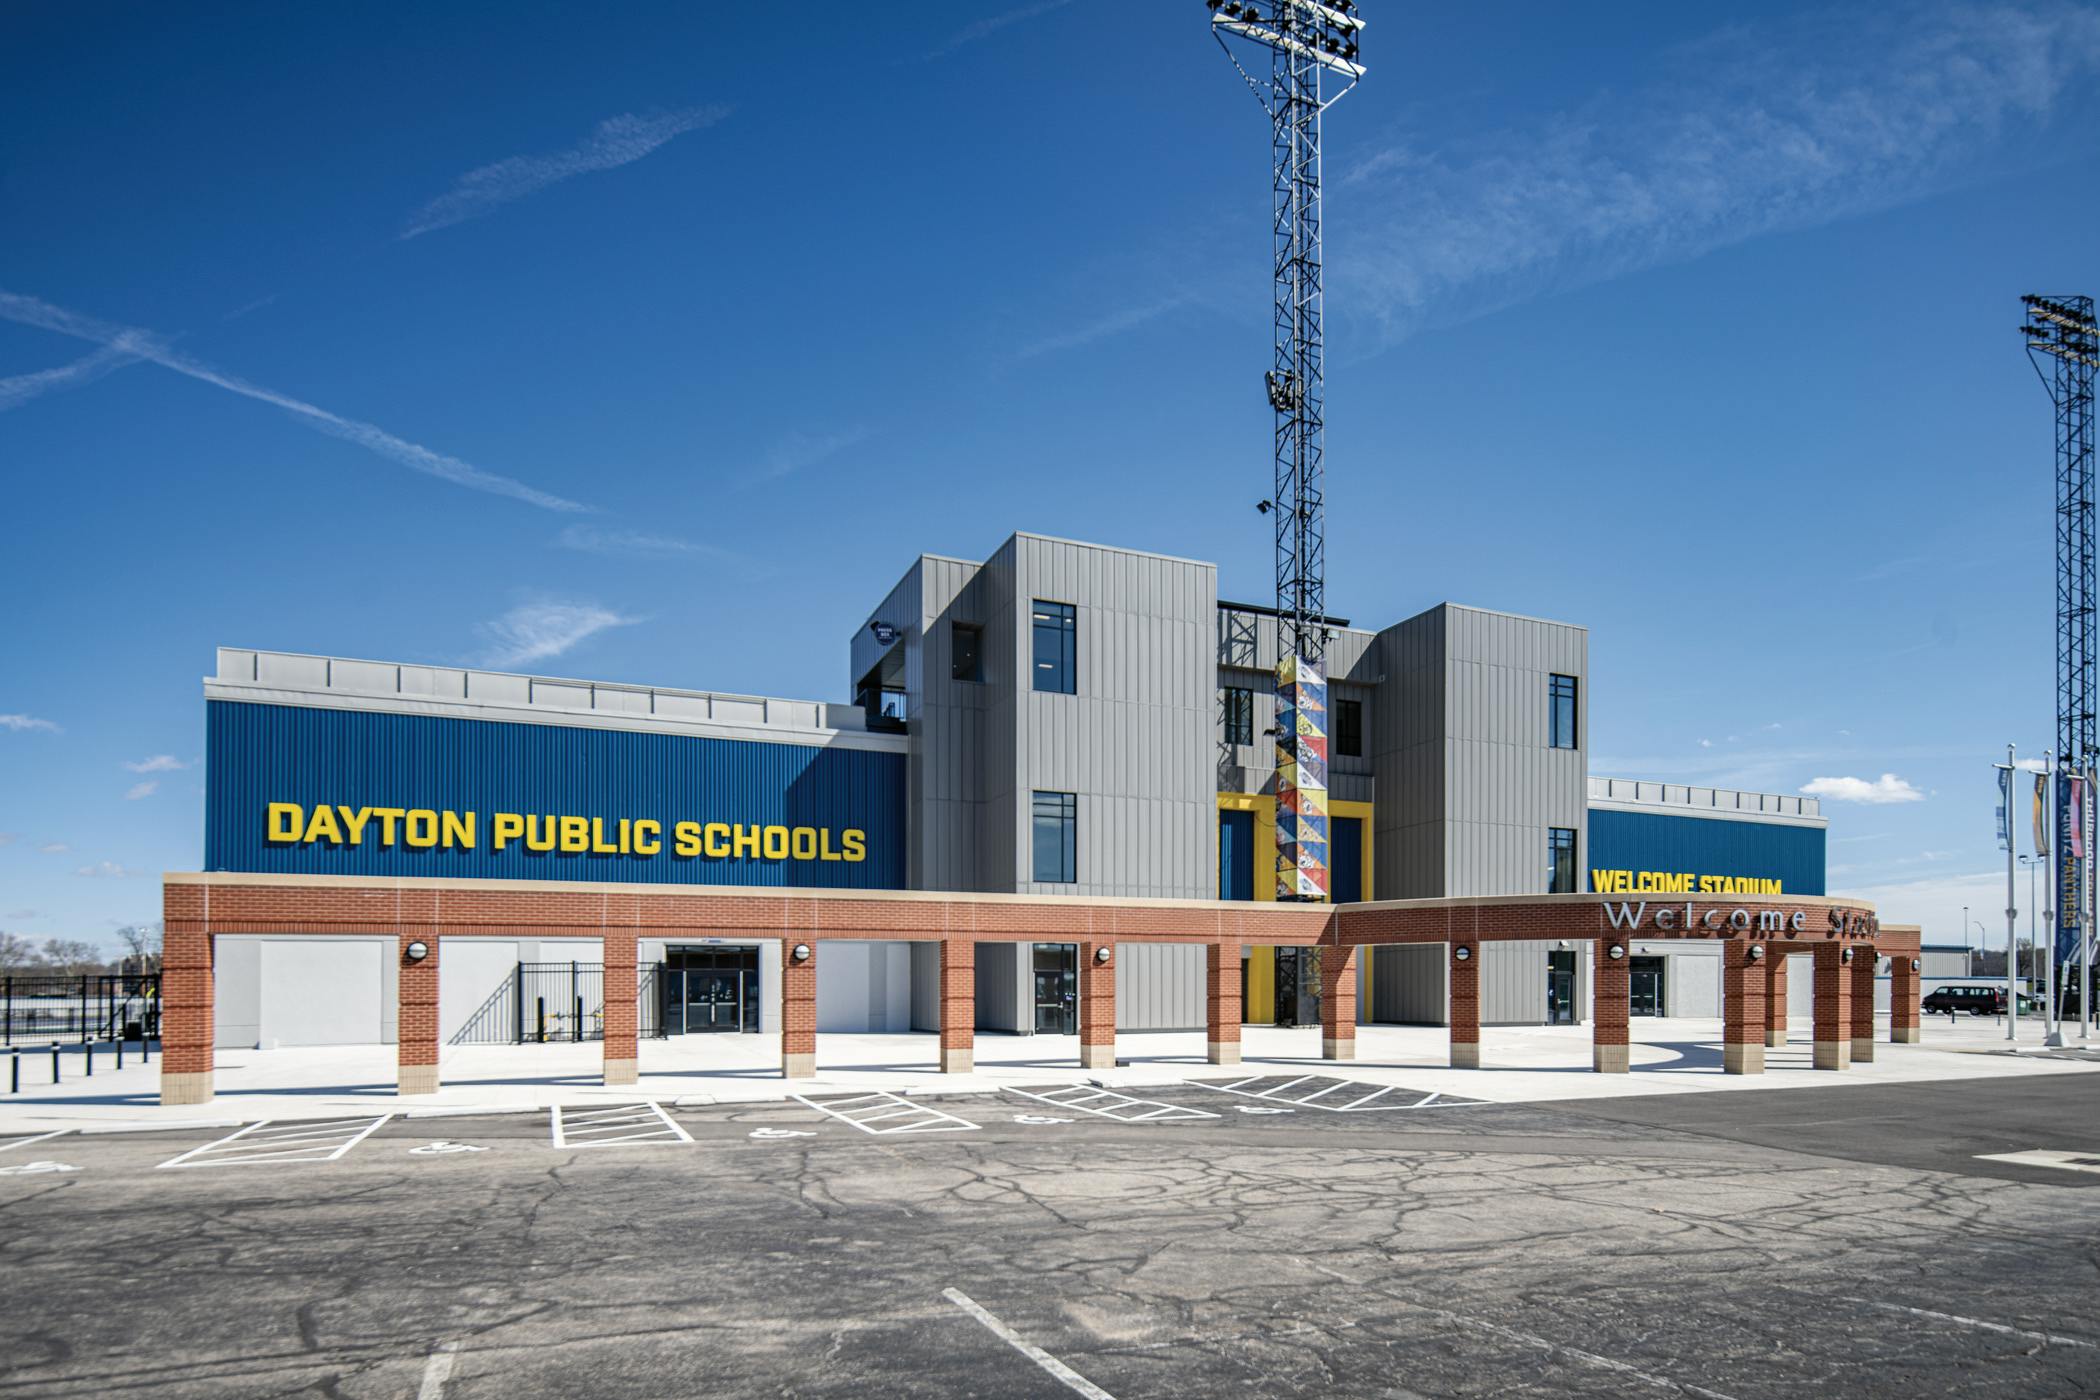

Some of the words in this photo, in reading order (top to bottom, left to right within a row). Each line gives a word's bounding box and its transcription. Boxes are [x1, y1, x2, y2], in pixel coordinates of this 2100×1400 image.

[268, 802, 476, 849] DAYTON
[494, 812, 662, 855] PUBLIC
[675, 821, 866, 862] SCHOOLS
[1591, 869, 1695, 893] WELCOME
[1699, 875, 1782, 895] STADIUM
[2063, 857, 2077, 929] PANTHERS
[1602, 902, 1807, 931] Welcome
